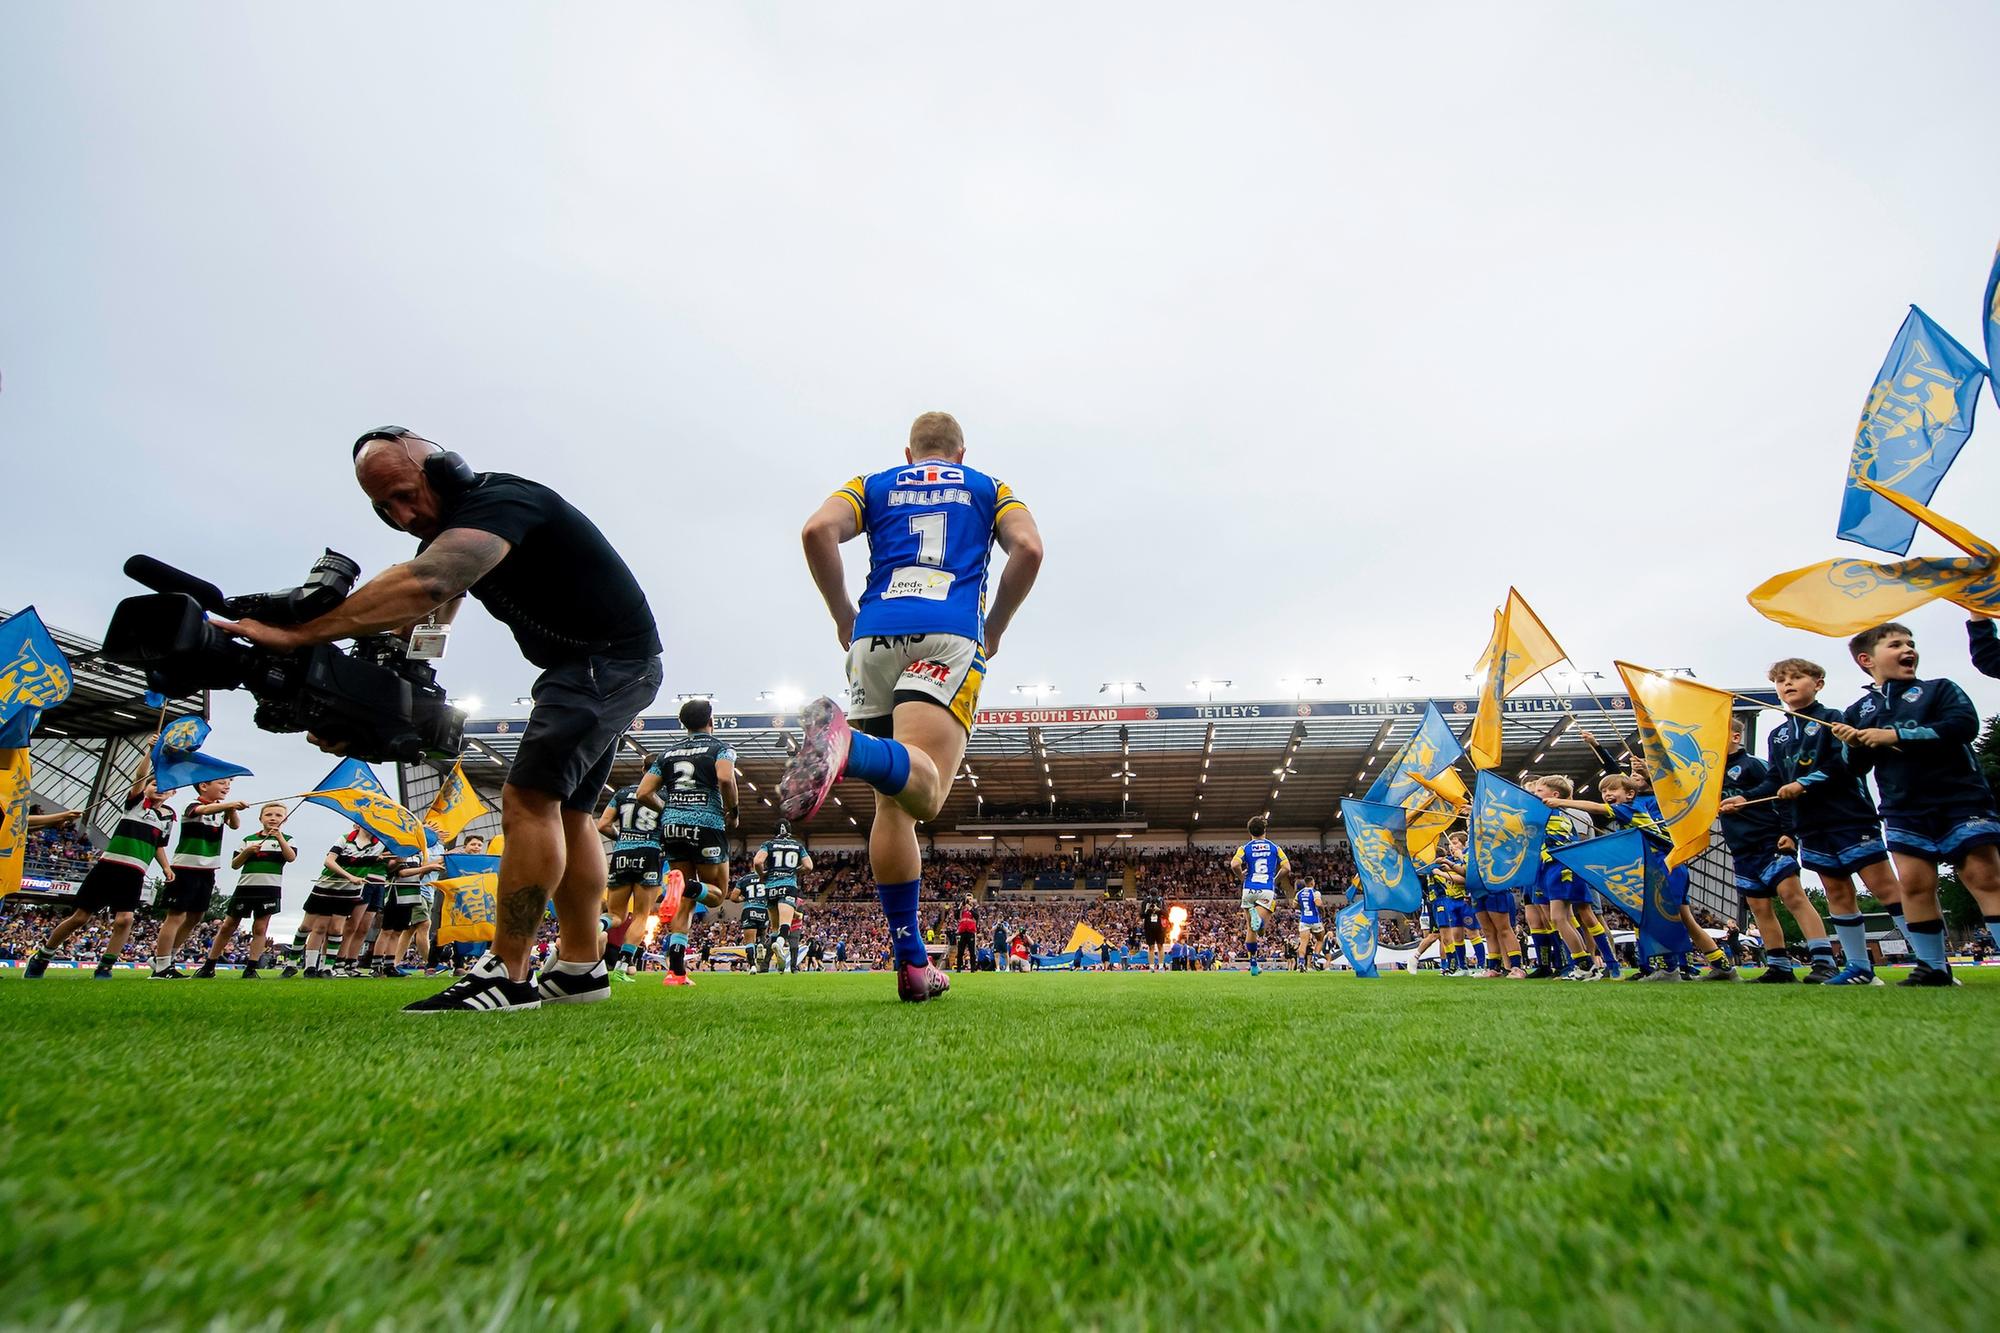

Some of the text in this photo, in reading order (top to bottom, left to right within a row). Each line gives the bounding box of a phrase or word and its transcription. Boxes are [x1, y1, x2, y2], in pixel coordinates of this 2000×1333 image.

[888, 489, 971, 506] MILLER
[909, 511, 947, 568] 1
[1195, 705, 1260, 718] TETLEY'S
[1349, 702, 1416, 715] TETLEY'S
[1505, 699, 1573, 712] TETLEY'S
[975, 709, 1118, 724] TLEY'S SOUTH STAND
[673, 760, 697, 790] 2
[620, 803, 659, 831] 18
[664, 823, 701, 840] iDuct
[616, 856, 646, 869] iDuct
[772, 851, 799, 868] 10
[1254, 858, 1268, 873] 6
[21, 879, 51, 889] TFRED
[746, 883, 766, 898] 13
[1302, 901, 1313, 916] 5
